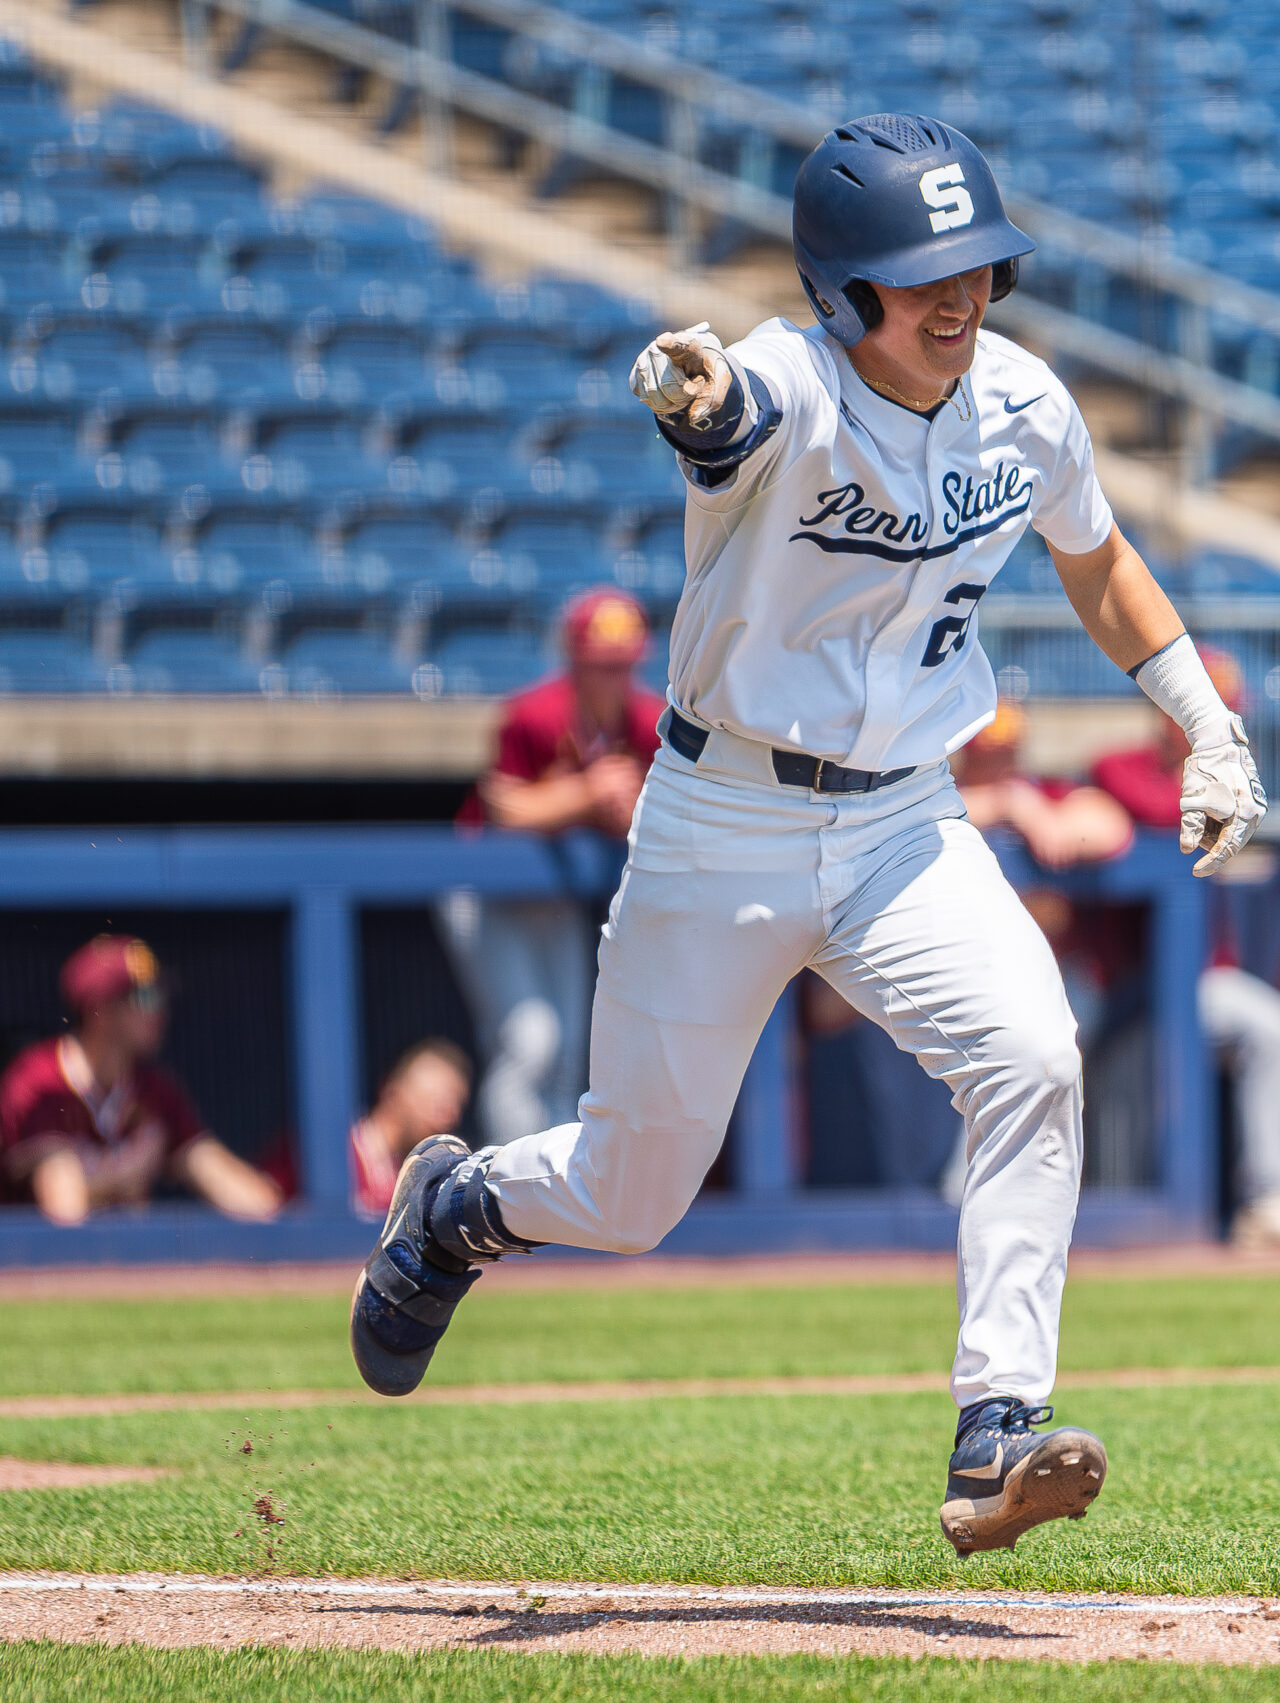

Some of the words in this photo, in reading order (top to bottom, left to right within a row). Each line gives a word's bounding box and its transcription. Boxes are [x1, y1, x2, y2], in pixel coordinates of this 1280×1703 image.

[918, 162, 975, 234] S
[799, 482, 928, 543] Penn
[942, 461, 1033, 535] State
[920, 582, 987, 667] 2
